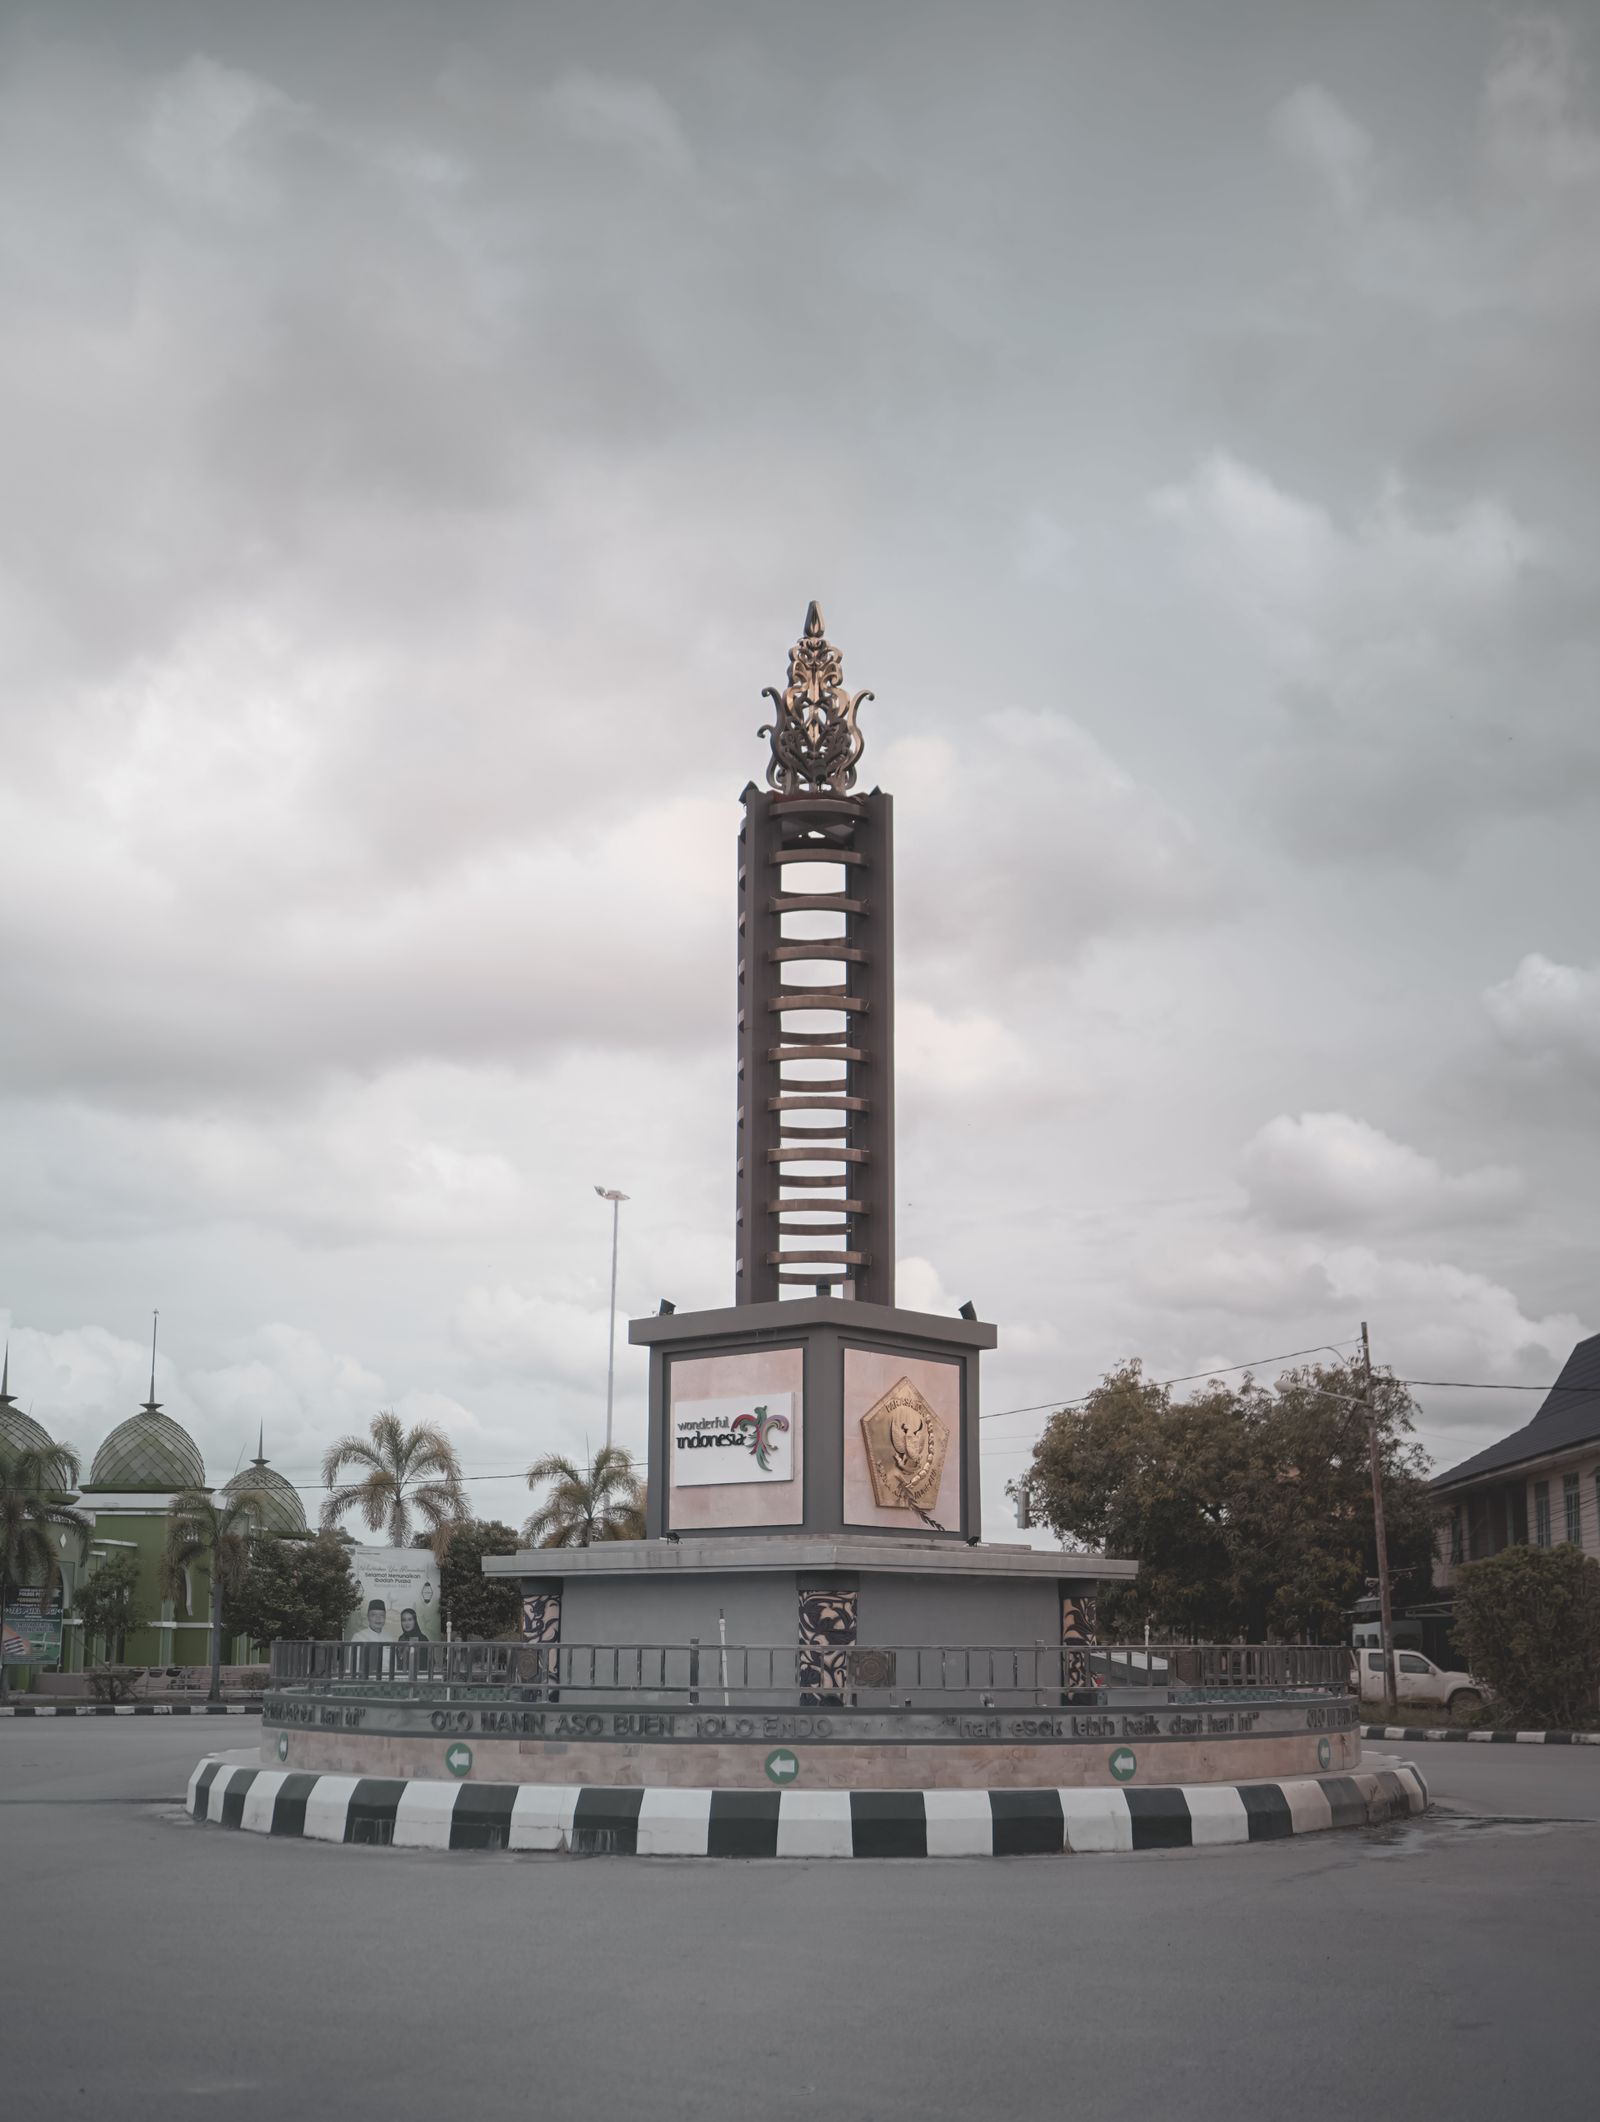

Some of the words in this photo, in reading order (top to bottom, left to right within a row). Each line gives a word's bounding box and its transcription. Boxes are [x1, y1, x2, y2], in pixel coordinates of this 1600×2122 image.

[677, 1416, 730, 1431] wonderful
[676, 1431, 747, 1450] indonesia
[431, 1710, 474, 1731] OLO
[554, 1713, 603, 1735] ASO
[613, 1713, 675, 1737] BUEN
[1169, 1714, 1203, 1734] dari
[1207, 1712, 1234, 1733] hari
